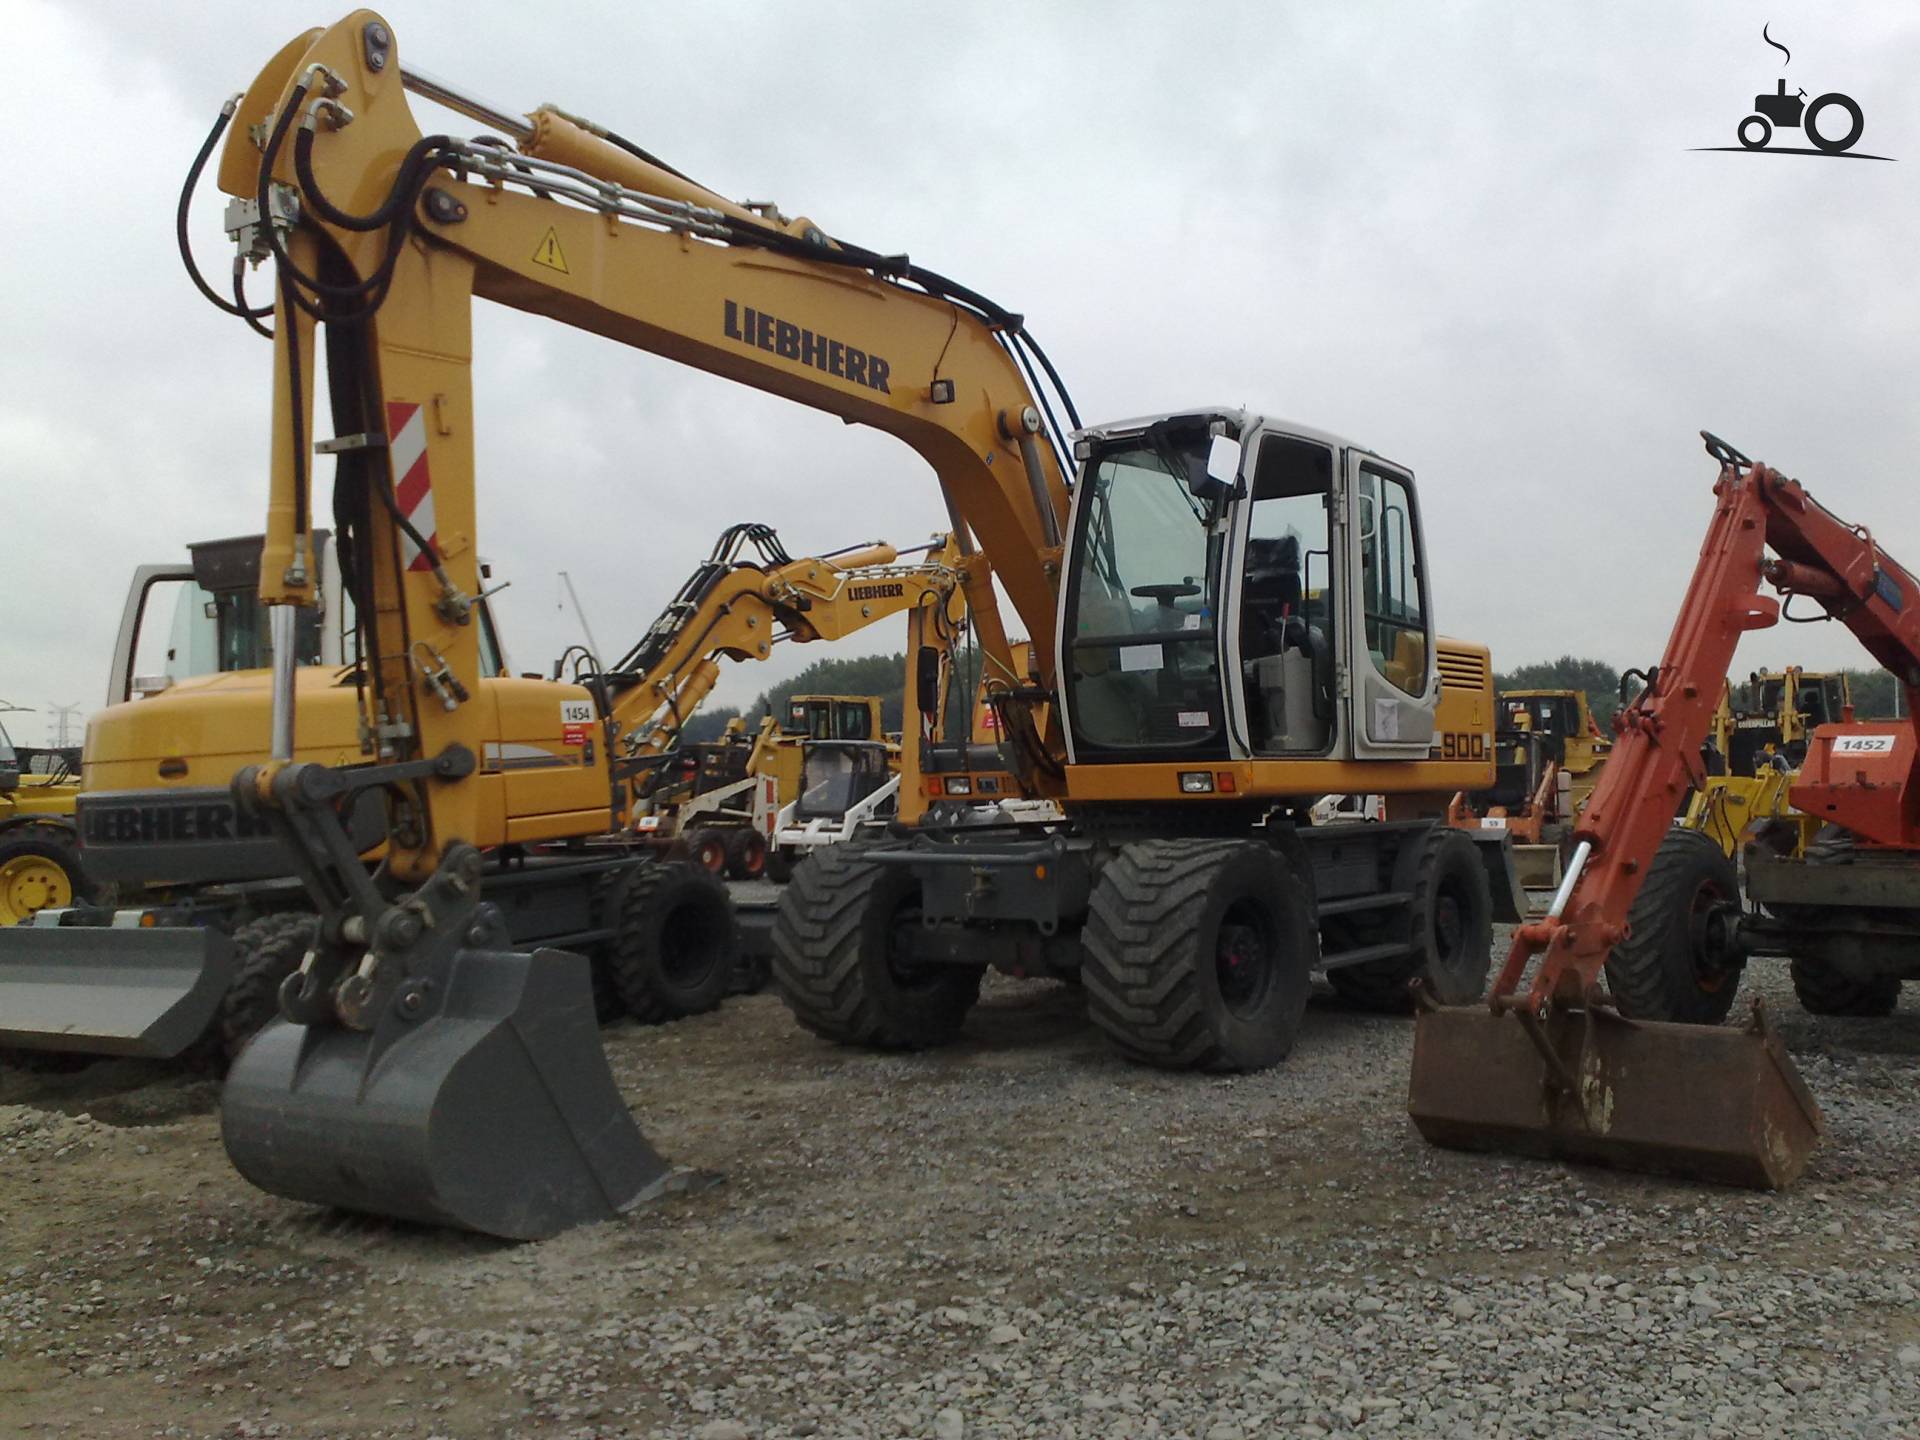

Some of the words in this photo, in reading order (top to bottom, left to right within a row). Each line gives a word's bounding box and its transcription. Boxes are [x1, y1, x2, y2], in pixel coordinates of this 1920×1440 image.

[724, 299, 891, 395] LIEBHERR
[847, 583, 904, 601] LIEBHERR
[566, 707, 590, 720] 1454
[1443, 733, 1483, 757] 900
[1843, 740, 1886, 750] 1452
